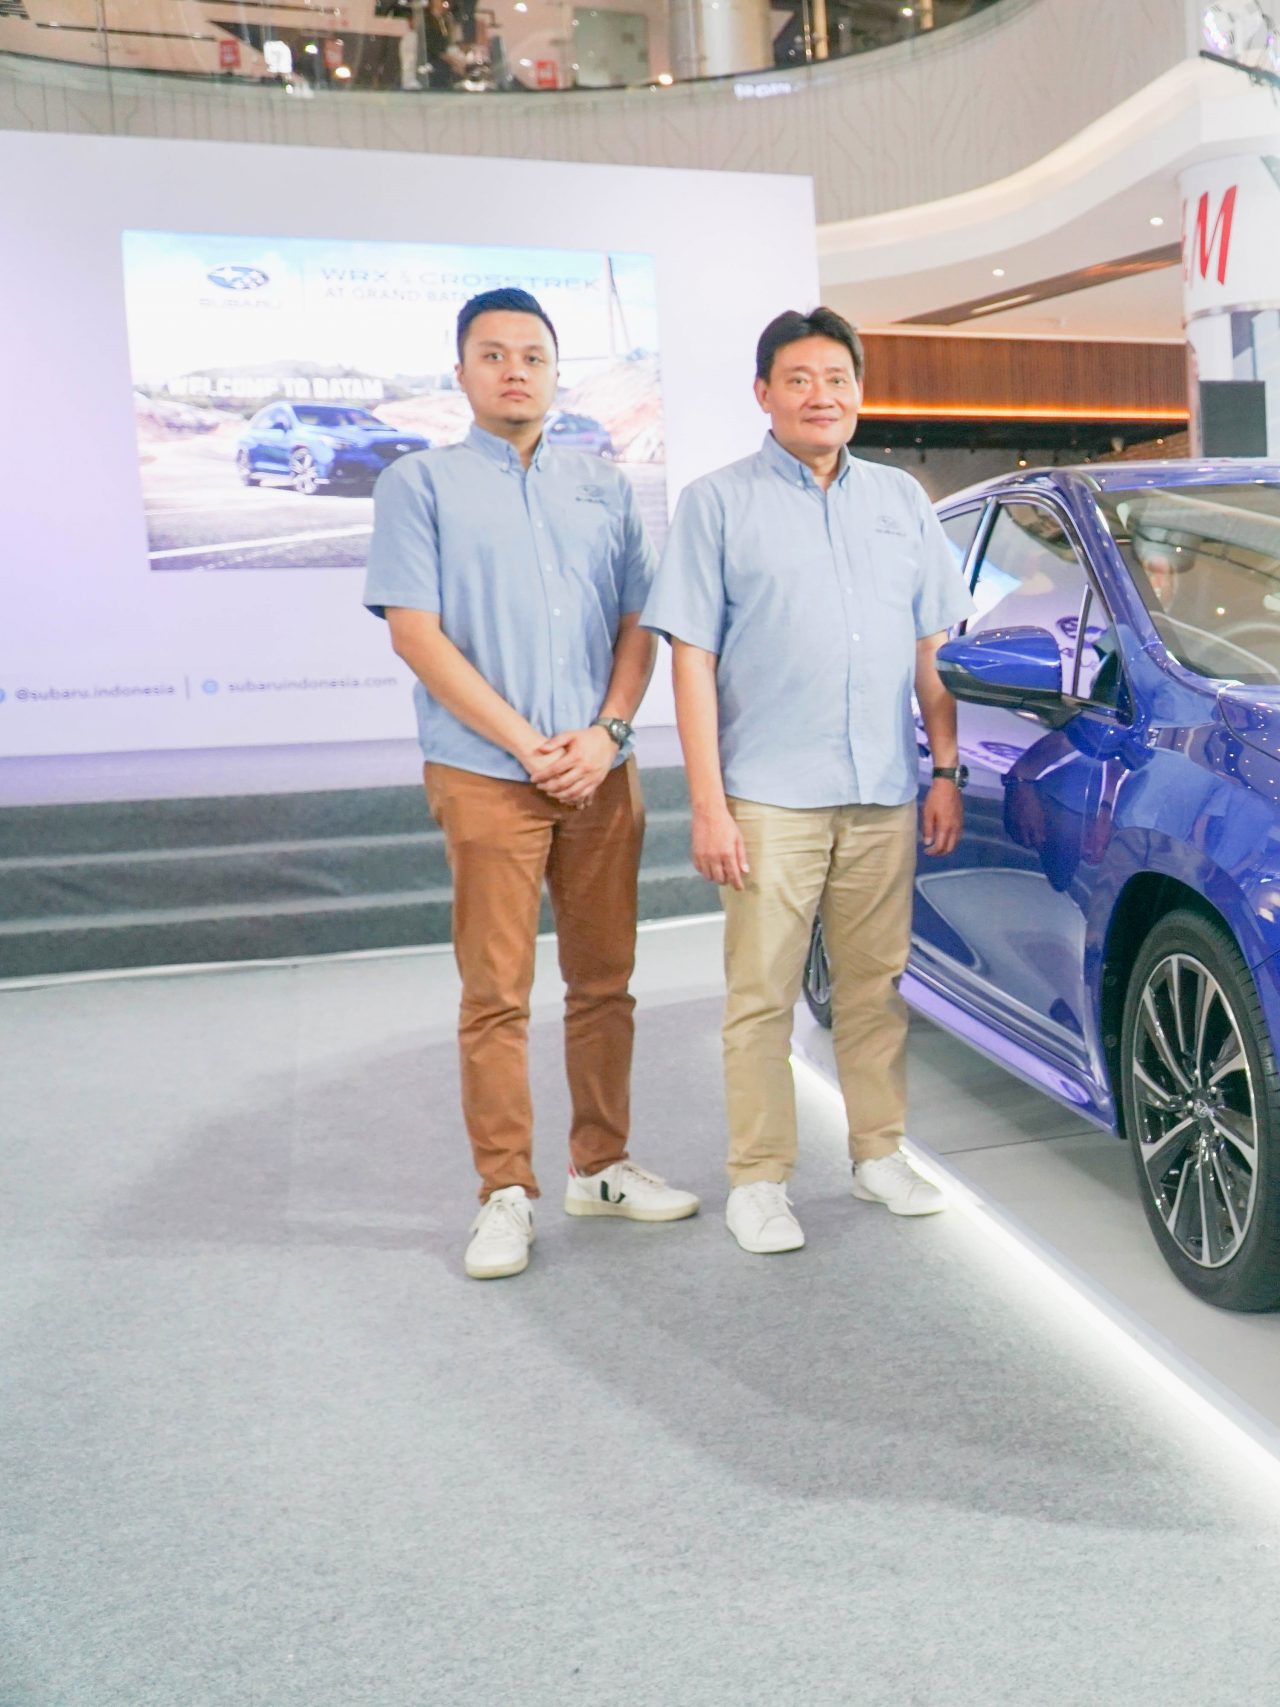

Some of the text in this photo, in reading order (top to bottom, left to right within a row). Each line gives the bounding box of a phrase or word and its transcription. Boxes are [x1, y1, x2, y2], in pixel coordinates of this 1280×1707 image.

[1182, 184, 1237, 289] M
[321, 267, 390, 283] WRX
[420, 271, 600, 290] CROSSTREK
[351, 287, 422, 301] GRAND
[427, 289, 476, 302] BATA
[227, 675, 399, 693] subaruindonesia.com
